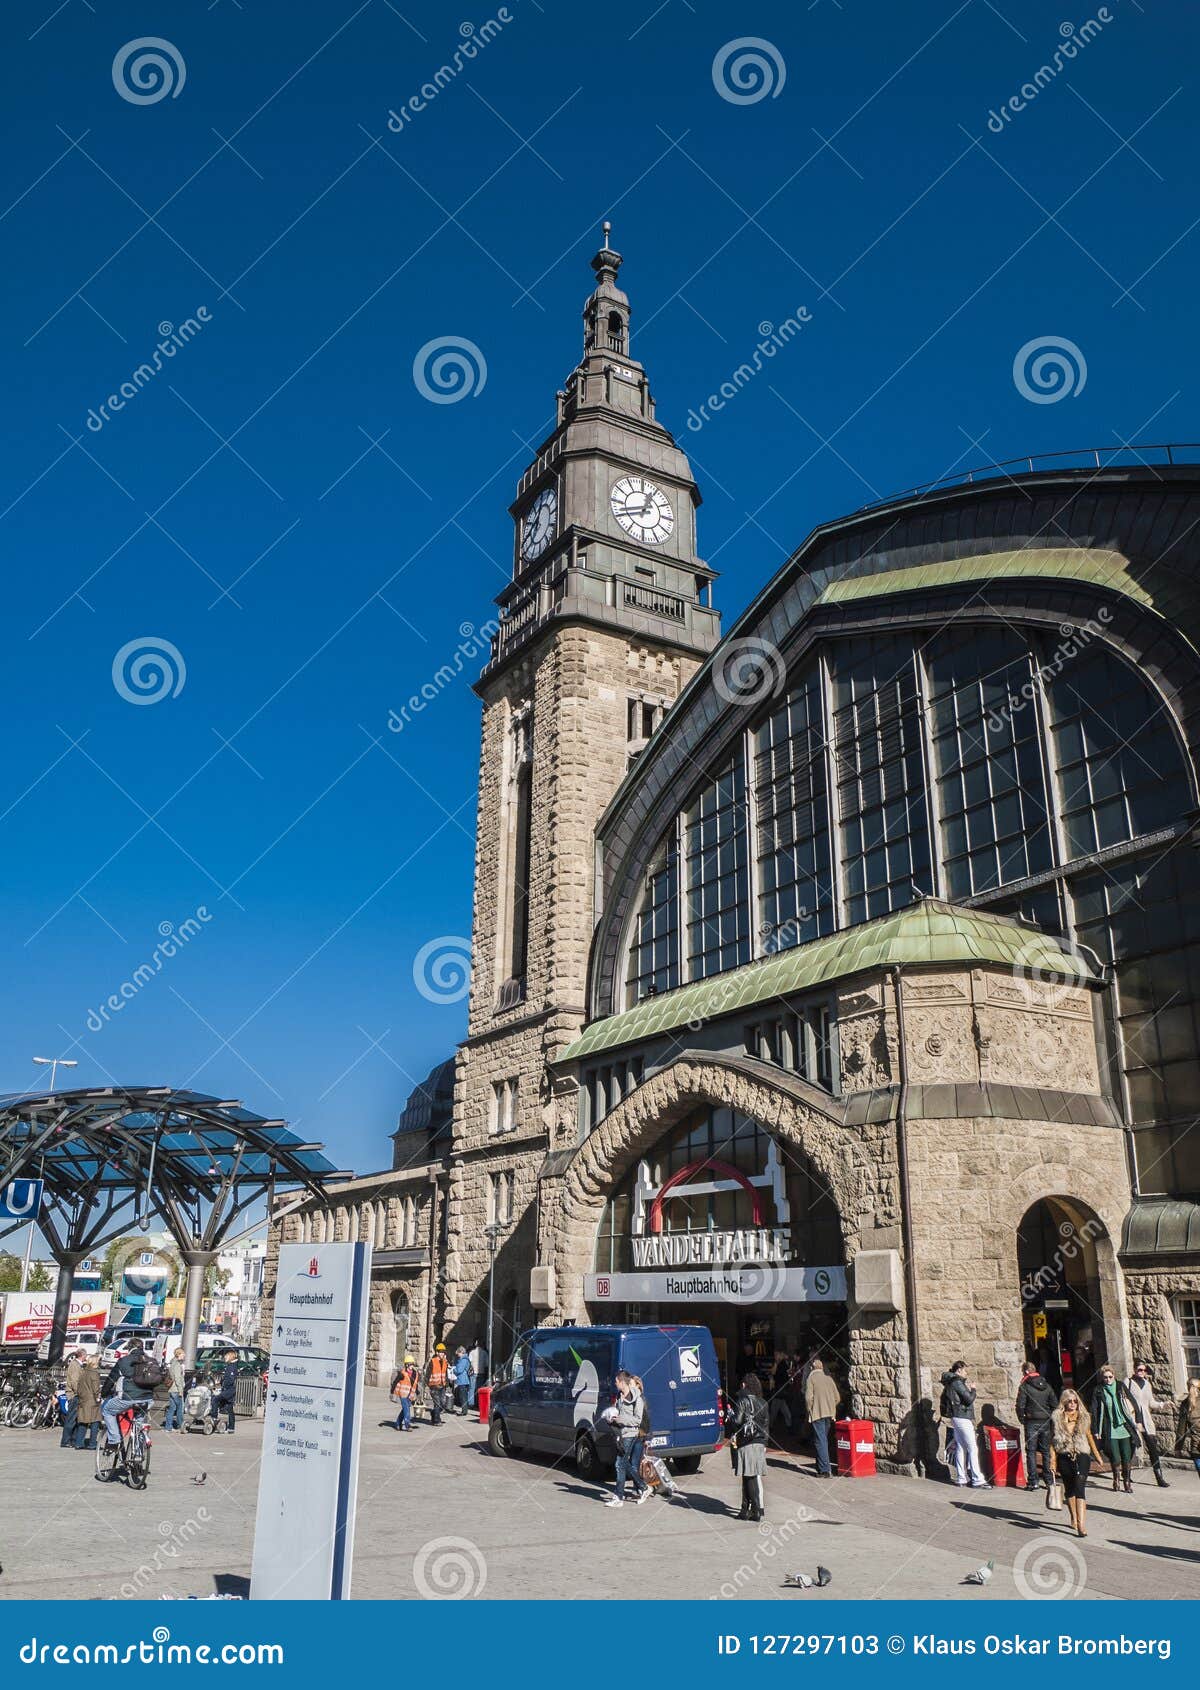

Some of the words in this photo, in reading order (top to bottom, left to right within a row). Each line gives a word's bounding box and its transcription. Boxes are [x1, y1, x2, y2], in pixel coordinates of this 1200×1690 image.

[6, 1182, 37, 1216] U
[631, 1227, 793, 1268] WANDELHALLE
[598, 1280, 610, 1295] DB
[666, 1271, 743, 1298] Hauptbahnhof
[816, 1272, 830, 1294] S
[289, 1293, 333, 1307] Hauptbahnhof
